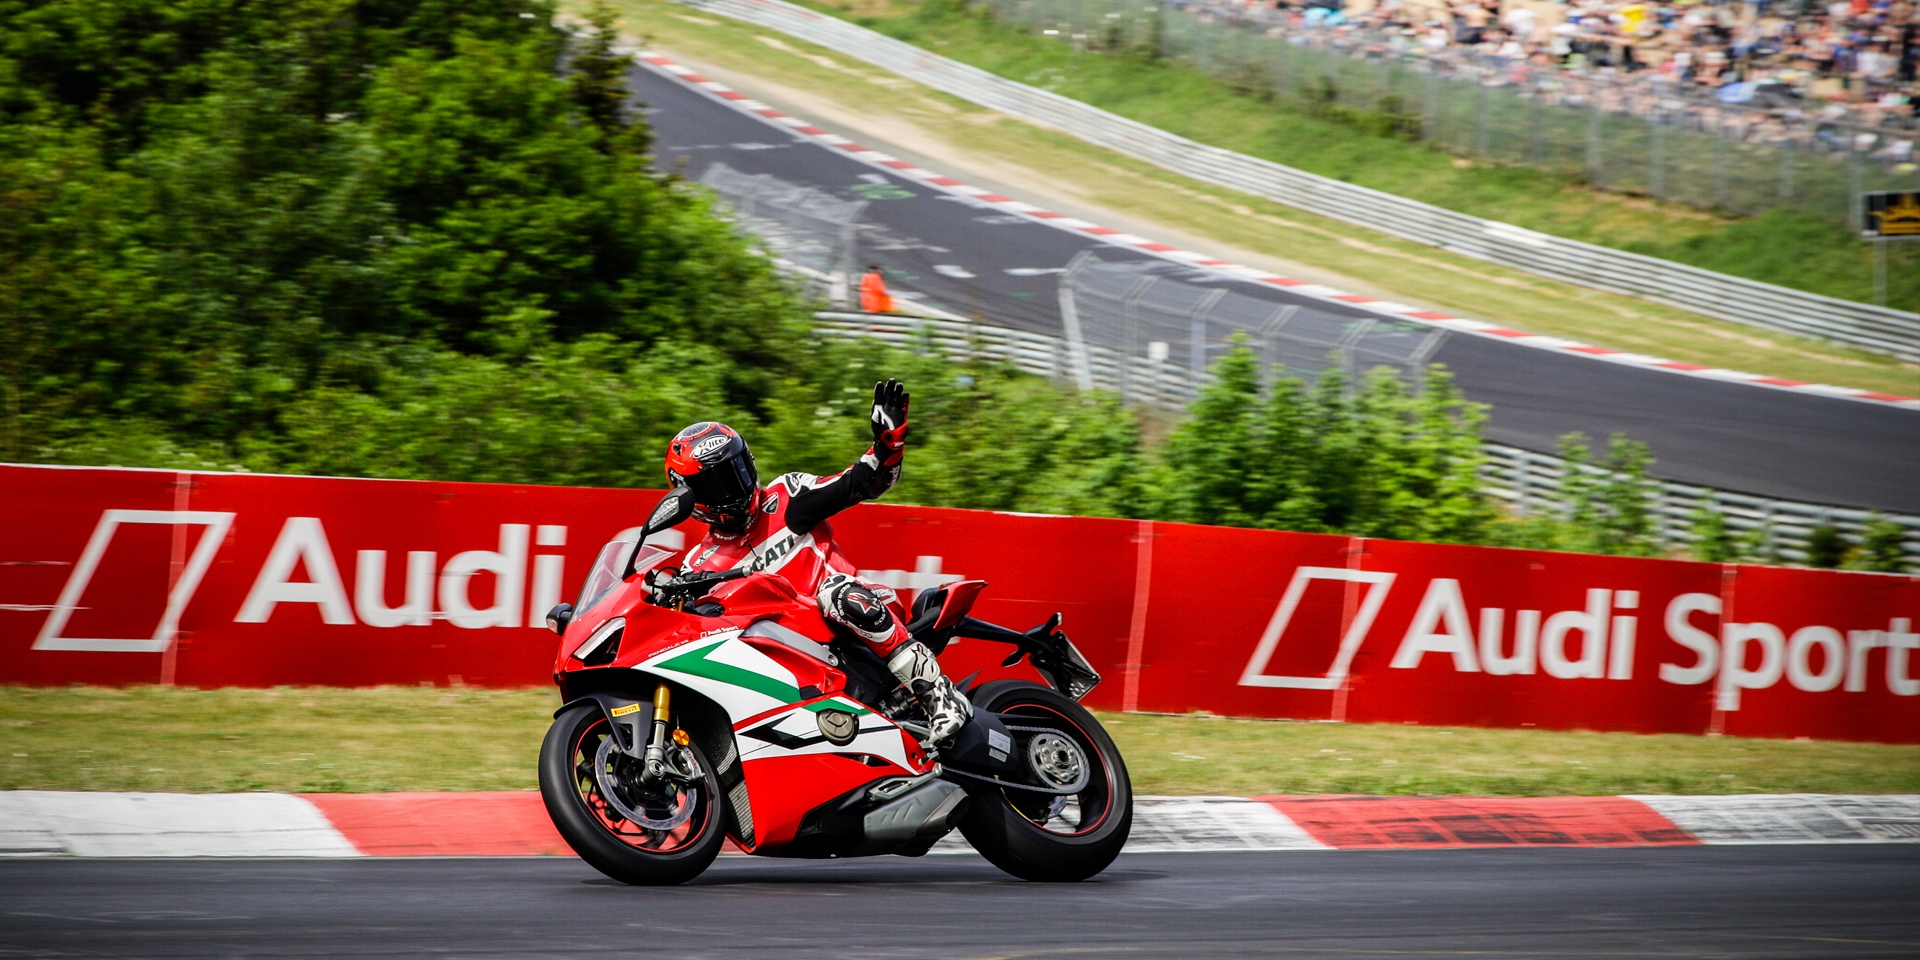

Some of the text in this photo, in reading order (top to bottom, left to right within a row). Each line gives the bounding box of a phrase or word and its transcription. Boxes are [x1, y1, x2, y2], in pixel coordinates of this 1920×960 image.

[234, 516, 568, 628] Audi
[752, 534, 795, 571] CATI
[1390, 578, 1920, 711] Audi Sport
